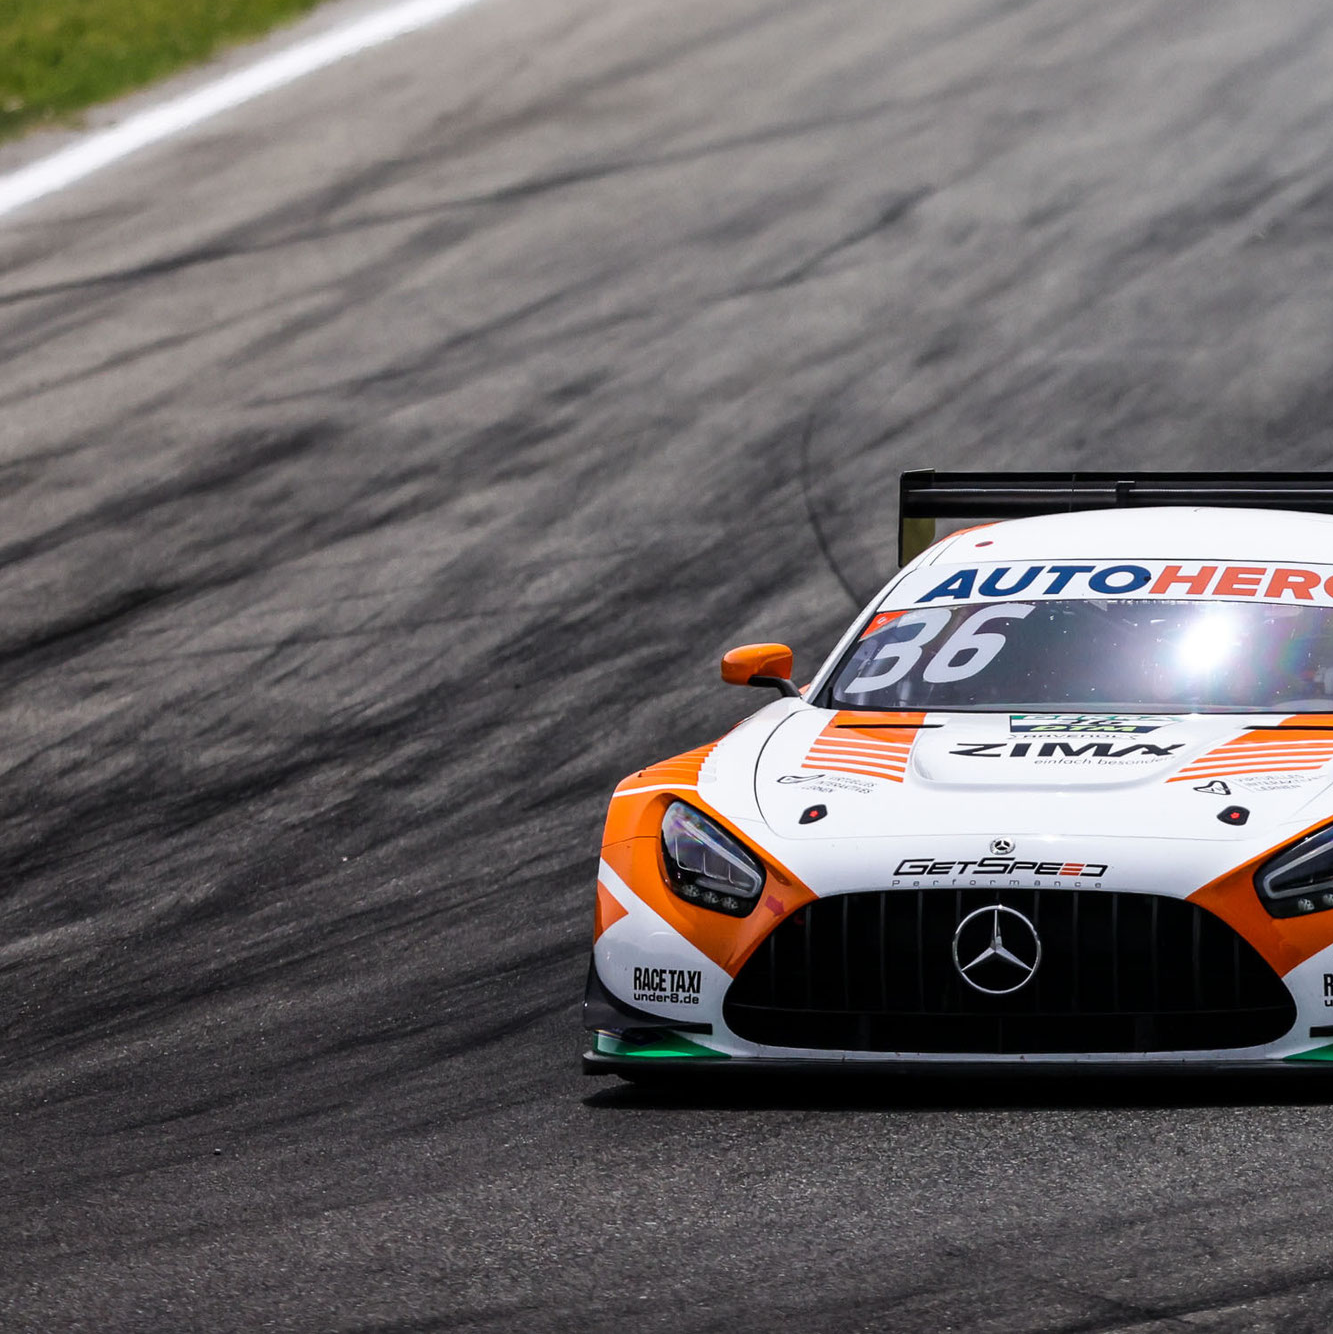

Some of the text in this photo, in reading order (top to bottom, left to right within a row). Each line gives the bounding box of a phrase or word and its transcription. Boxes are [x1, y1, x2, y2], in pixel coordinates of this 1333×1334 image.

[844, 602, 1035, 695] 36
[892, 879, 1102, 888] Performance
[633, 992, 700, 1004] under8.de
